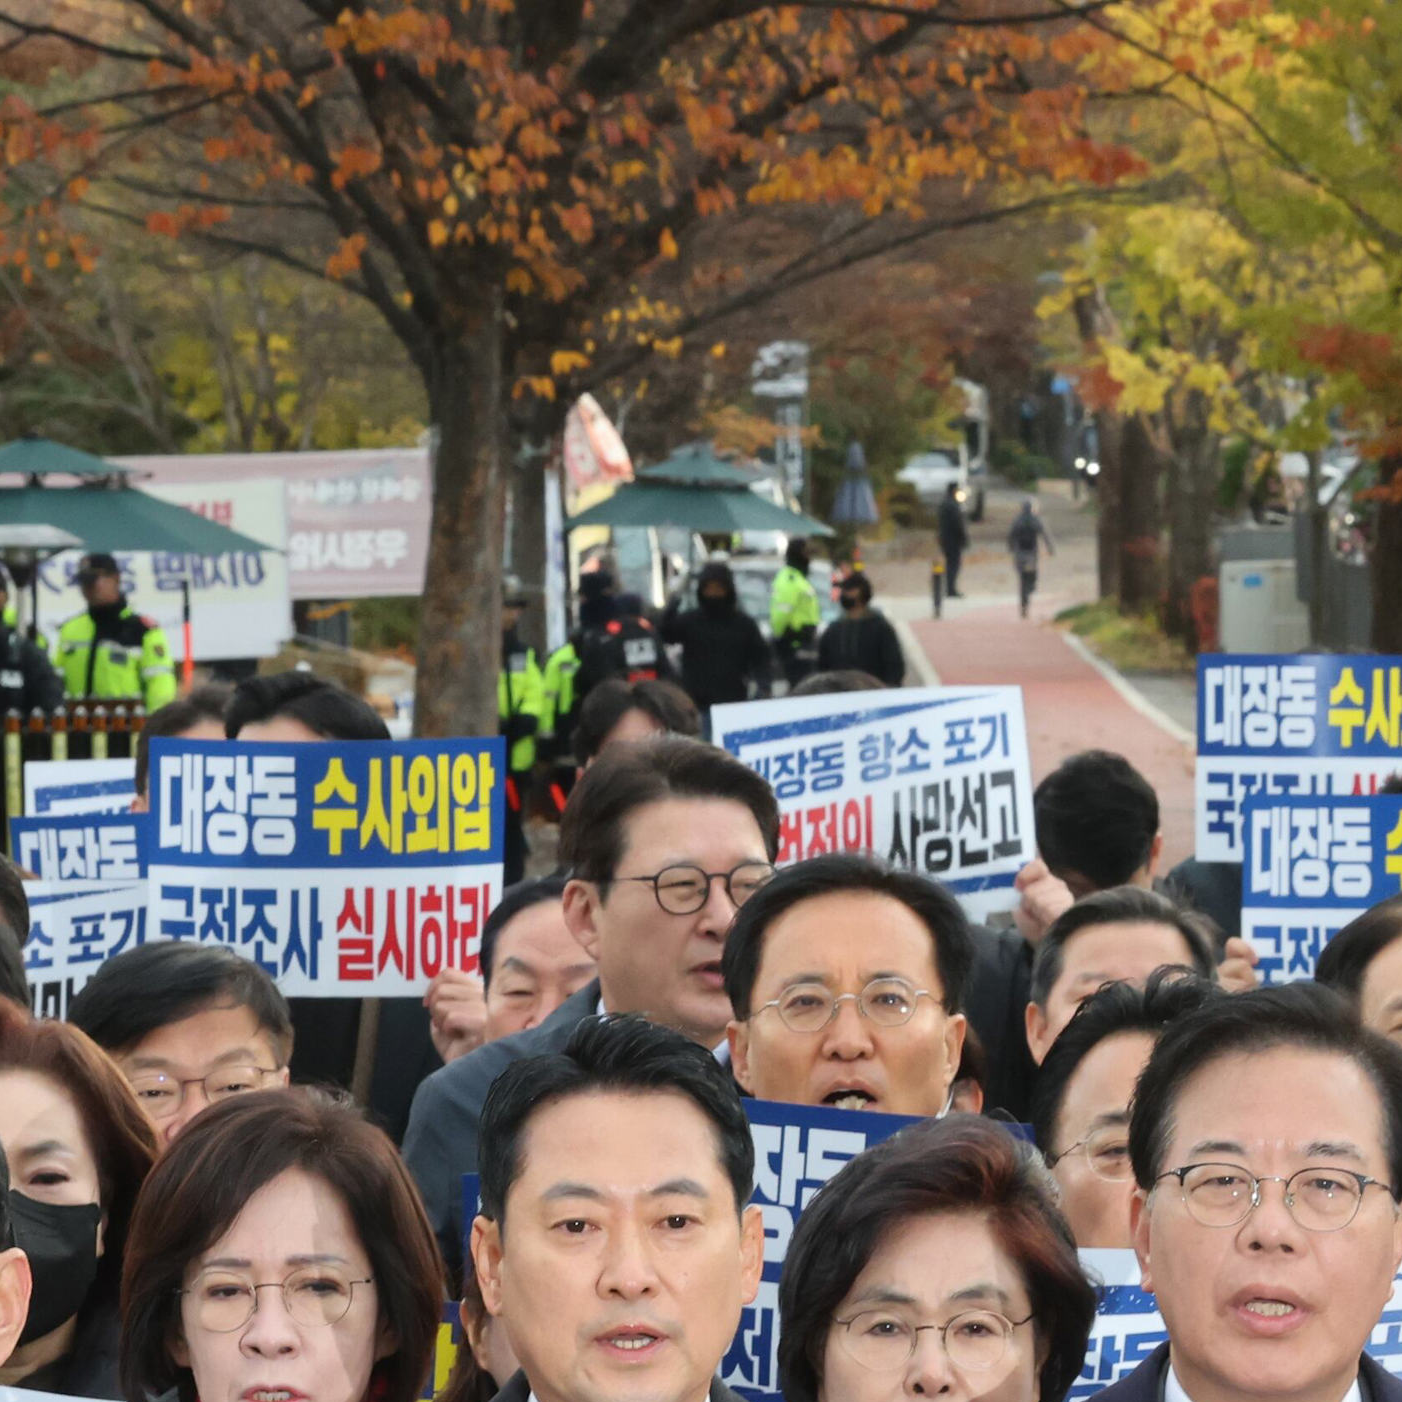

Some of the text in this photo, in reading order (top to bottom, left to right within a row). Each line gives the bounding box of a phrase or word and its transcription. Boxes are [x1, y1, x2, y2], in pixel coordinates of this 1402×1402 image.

[858, 727, 931, 783] 항소
[943, 712, 1010, 766] 포기
[1204, 664, 1317, 748] 대장동
[159, 752, 495, 857] 대장동 수사외압
[888, 769, 1023, 874] 사망선고
[1251, 806, 1373, 899] 대장동
[67, 906, 147, 965] 포기
